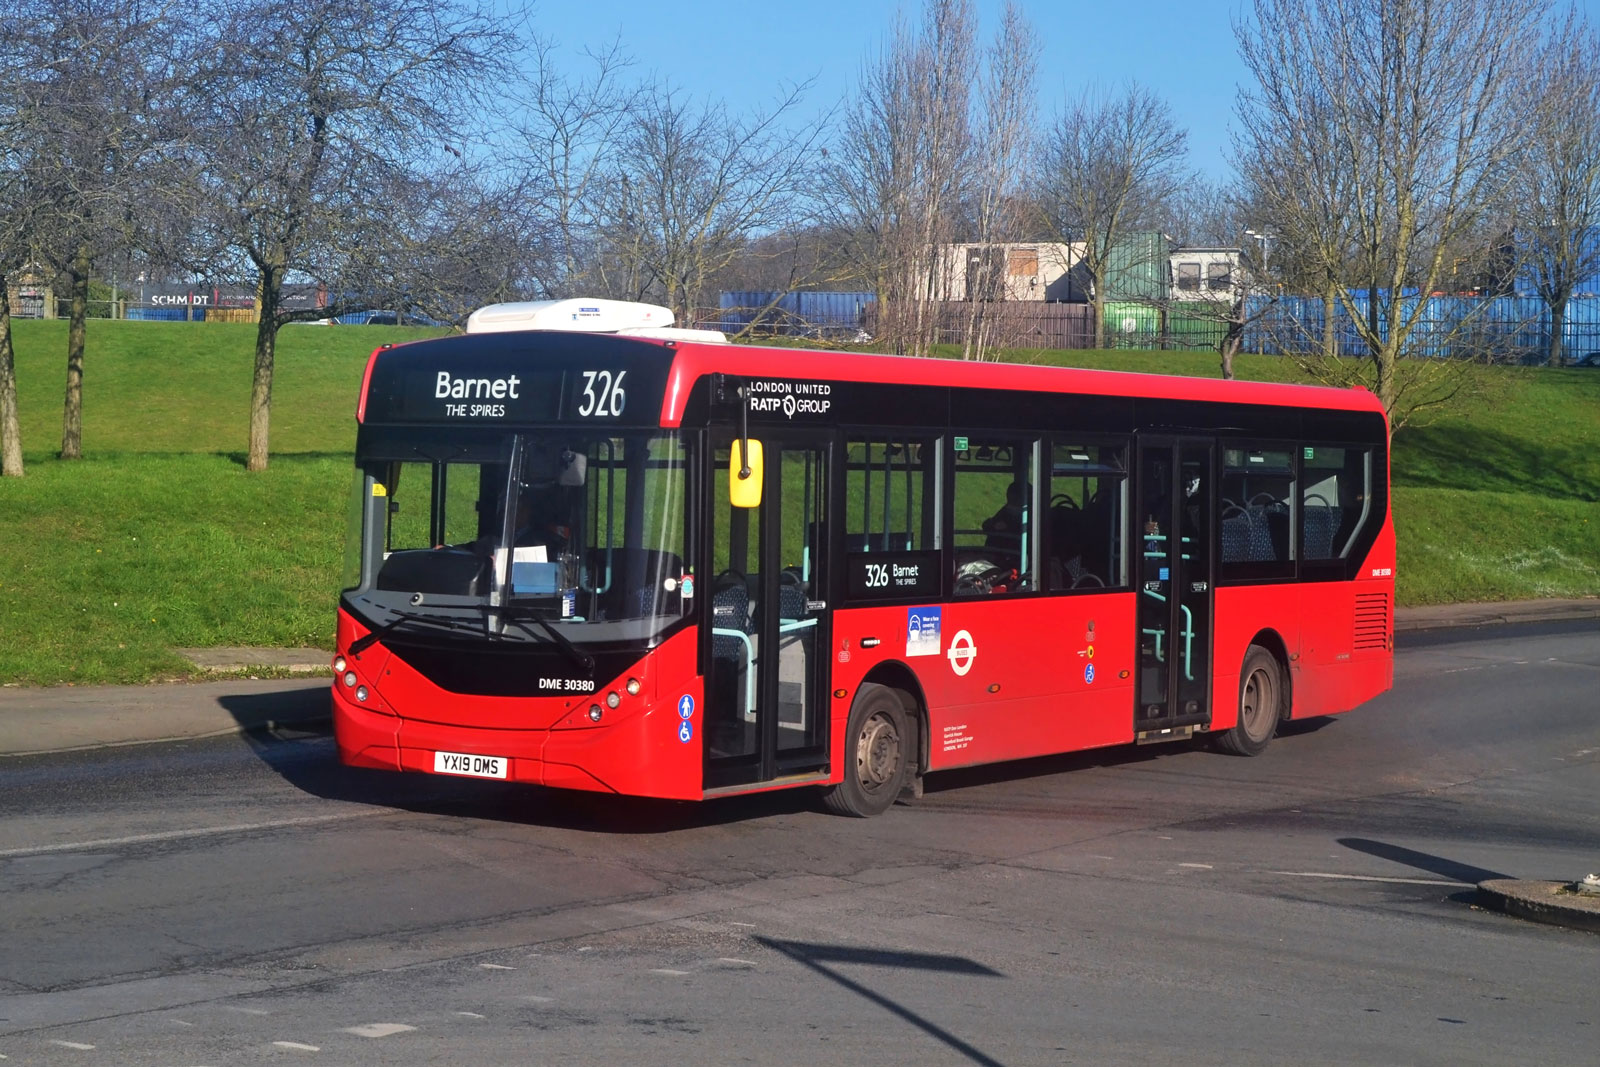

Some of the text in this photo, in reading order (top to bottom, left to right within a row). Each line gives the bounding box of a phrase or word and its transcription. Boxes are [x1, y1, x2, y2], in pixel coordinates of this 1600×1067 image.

[151, 291, 209, 306] SCHMIDT
[435, 371, 520, 399] Barnet
[750, 381, 831, 395] LONDON UNITED
[578, 370, 627, 417] 326
[446, 404, 505, 417] THE SPIRES
[750, 397, 831, 413] RATP GROUP
[865, 563, 919, 587] 326 Barnet
[895, 578, 917, 586] THE SPIRES
[538, 678, 595, 692] DME 30380
[443, 754, 499, 775] YX19 OMS
